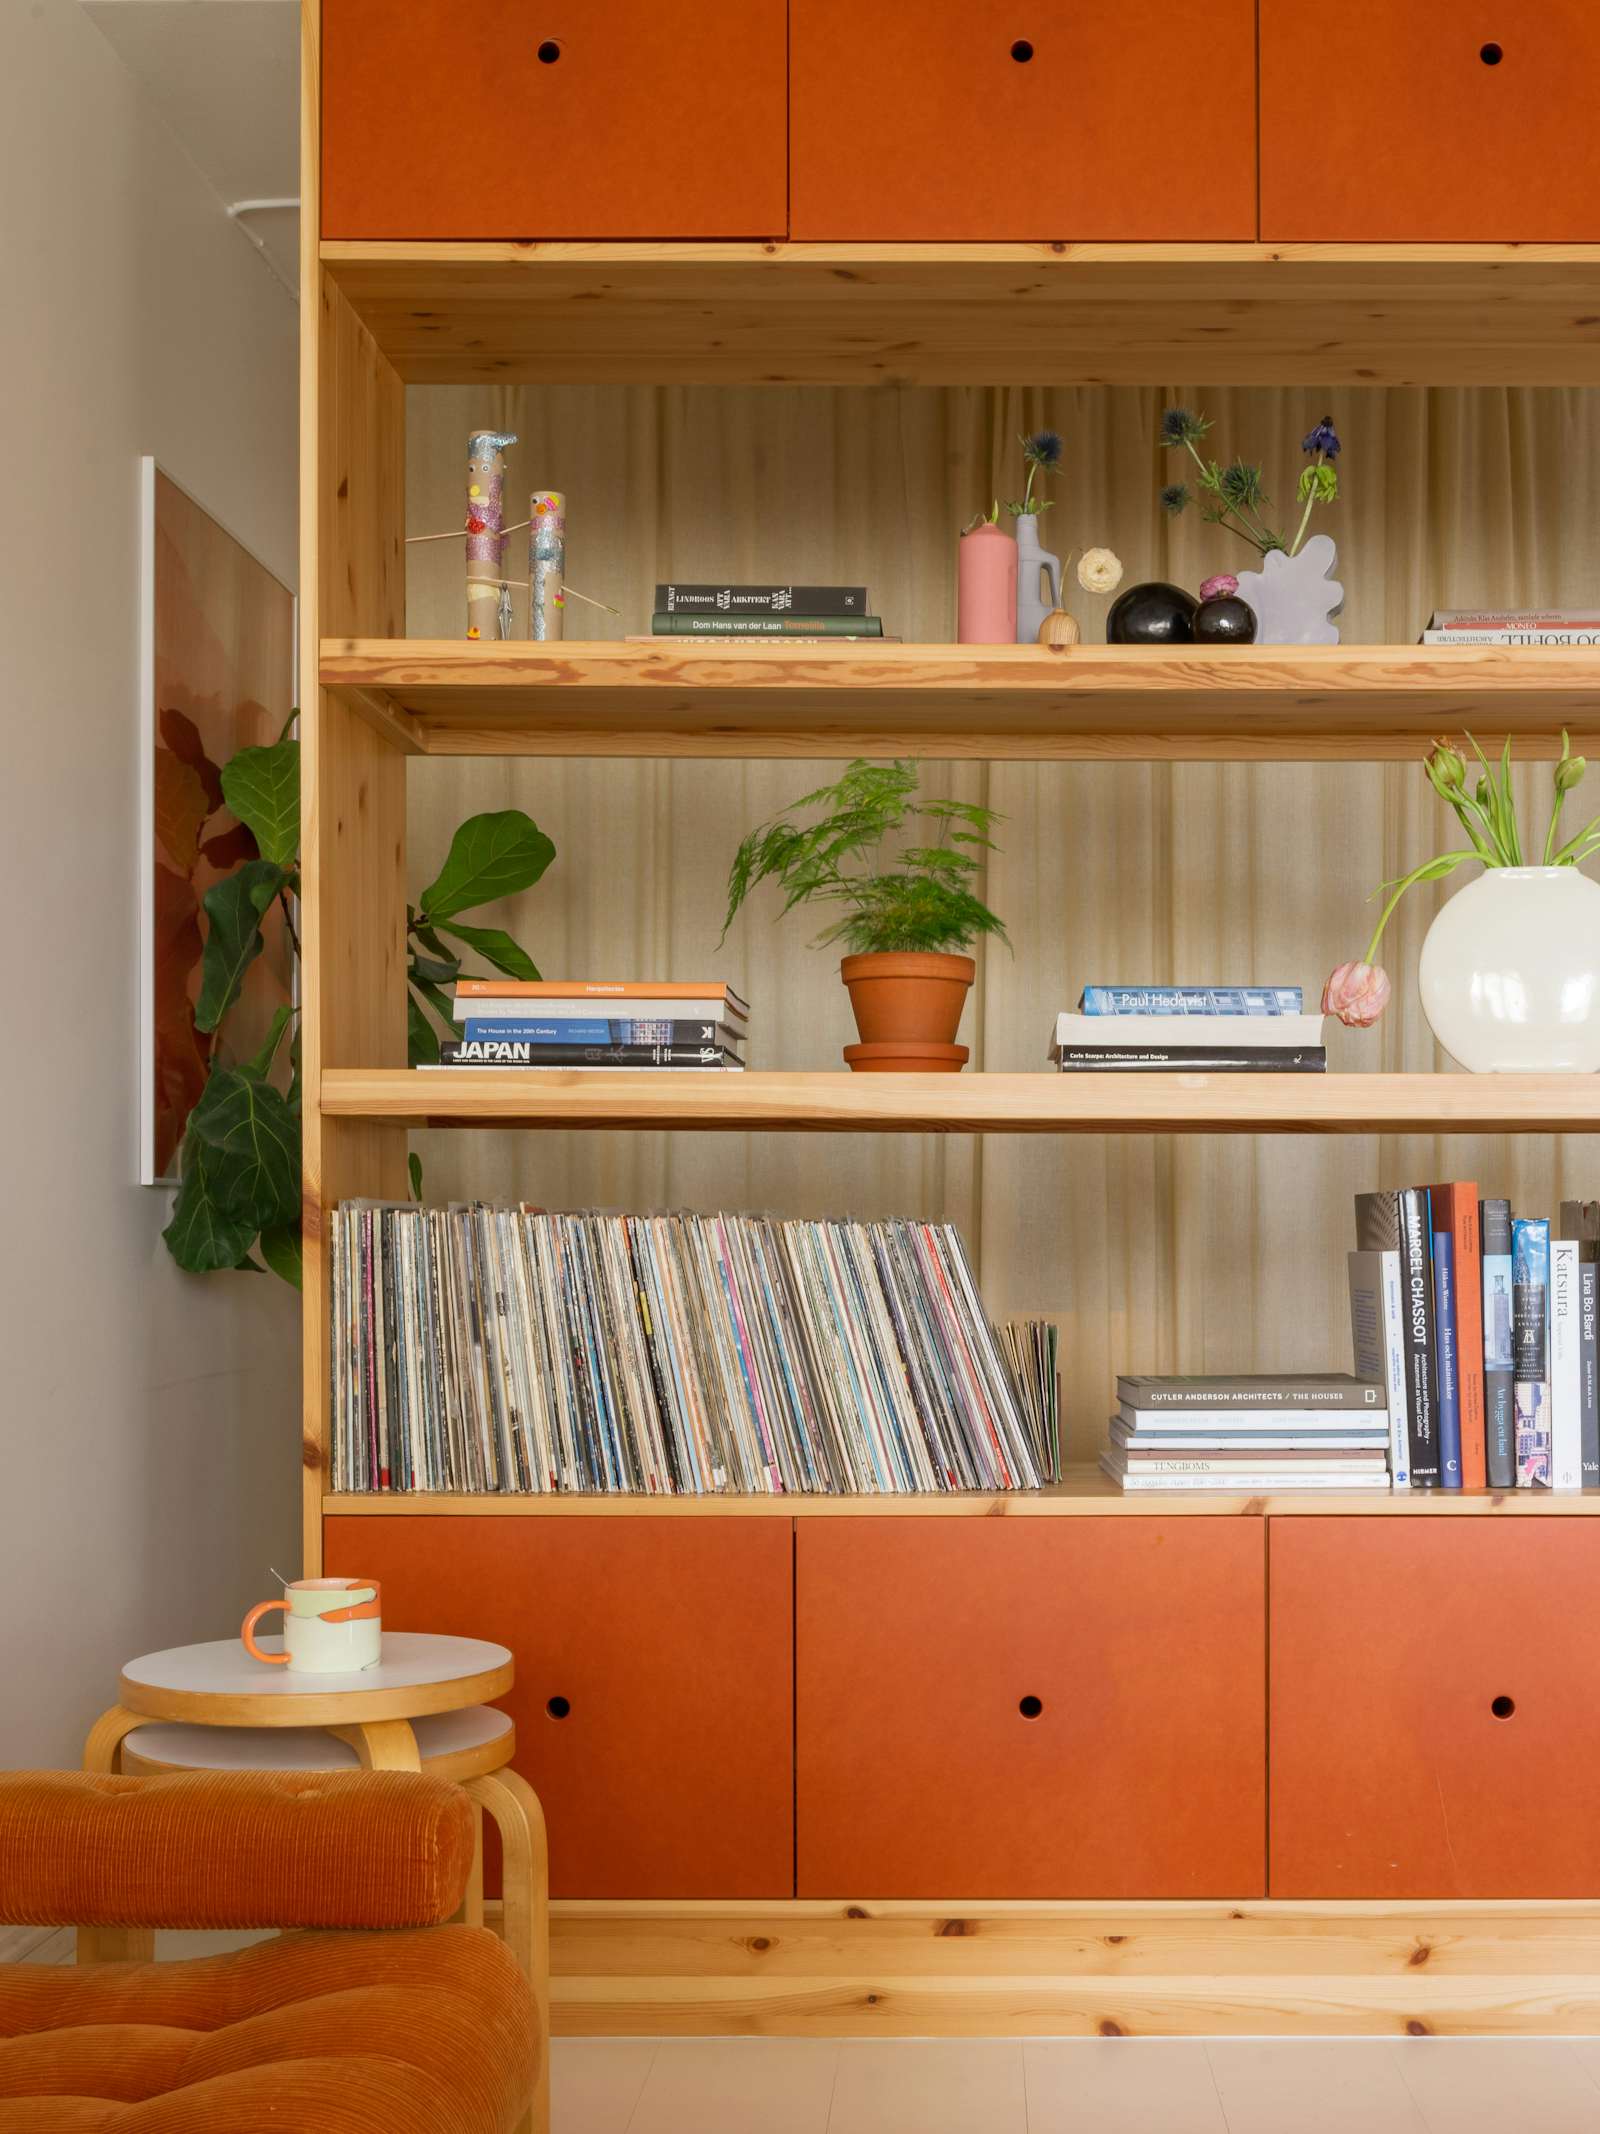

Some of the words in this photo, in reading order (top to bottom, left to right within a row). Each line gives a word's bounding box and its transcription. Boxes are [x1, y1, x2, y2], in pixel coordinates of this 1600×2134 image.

[676, 595, 714, 603] LINDROOS
[731, 596, 771, 604] ARKITEKT
[692, 621, 711, 629] Dom
[712, 621, 732, 629] Hans
[748, 622, 761, 630] der
[763, 622, 782, 630] Laan
[1122, 993, 1149, 1007] Paul
[1153, 993, 1208, 1008] Hedqvist
[536, 1028, 557, 1036] Century
[453, 1041, 530, 1060] JAPAN
[1085, 1053, 1104, 1061] Scarpa:
[1150, 1053, 1169, 1061] Design
[1407, 1216, 1423, 1275] MARCEL
[1556, 1249, 1573, 1317] Katsura
[1583, 1273, 1593, 1295] Lina
[1410, 1276, 1426, 1345] CHASSOT
[1583, 1297, 1593, 1312] Bo
[1584, 1314, 1594, 1340] Bardi
[1443, 1328, 1452, 1344] Hus
[1444, 1345, 1453, 1359] och
[1421, 1353, 1429, 1389] Architecture
[1444, 1360, 1454, 1400] människor
[1151, 1393, 1183, 1401] CUTLER
[1185, 1393, 1230, 1401] ANDERSON
[1232, 1393, 1283, 1401] ARCHITECTS
[1422, 1402, 1431, 1439] Photography
[1498, 1438, 1507, 1456] land
[1153, 1462, 1211, 1472] TENGBOMS
[1582, 1461, 1599, 1471] Yale
